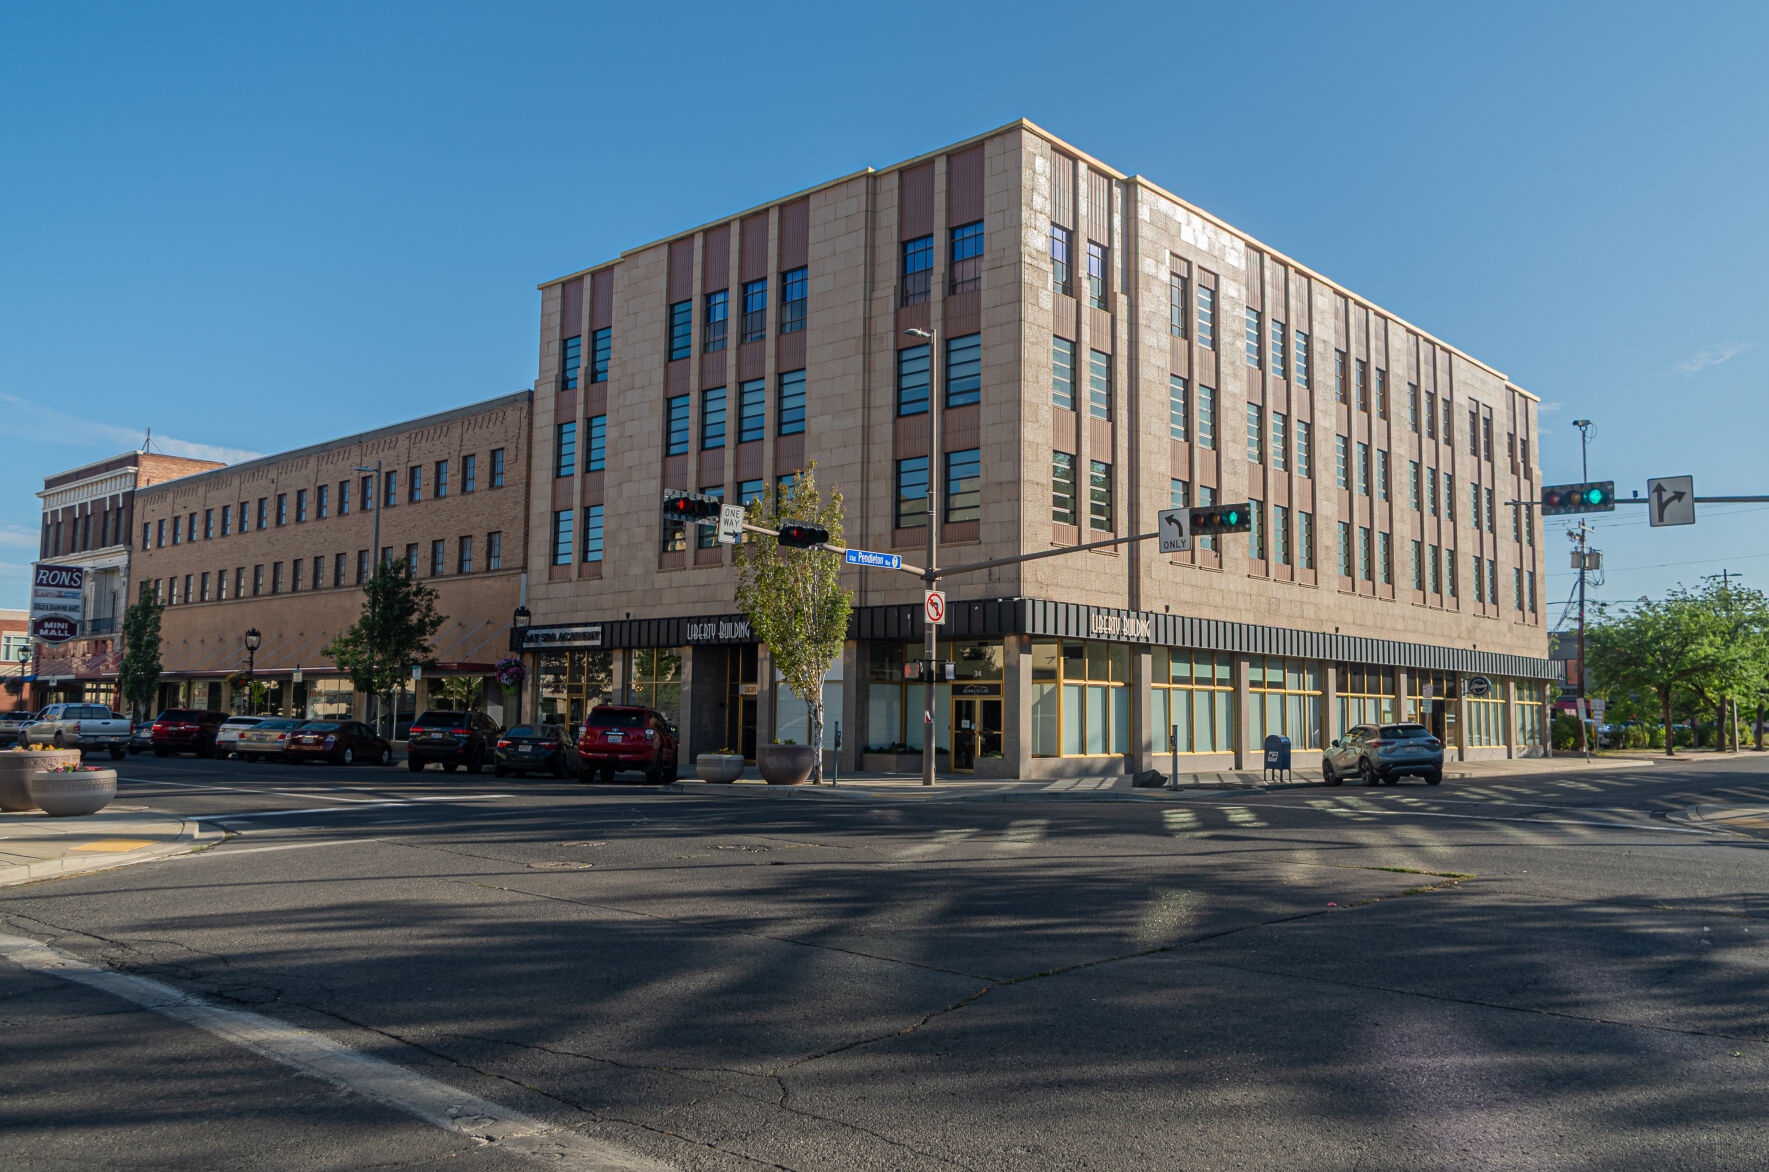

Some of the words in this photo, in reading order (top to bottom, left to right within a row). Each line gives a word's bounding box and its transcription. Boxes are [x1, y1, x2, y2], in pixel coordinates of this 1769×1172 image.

[725, 508, 740, 519] ONE
[723, 518, 740, 528] WAY
[1163, 539, 1187, 549] ONLY
[858, 551, 884, 565] Pendleton
[36, 568, 82, 587] RON'S
[44, 621, 69, 629] MINI
[687, 623, 717, 640] LIBERTY
[718, 620, 750, 639] BUILDING
[1091, 612, 1120, 635] LIBERTY
[1122, 615, 1150, 638] BUILDING
[39, 628, 71, 636] MALL
[974, 670, 982, 678] 34
